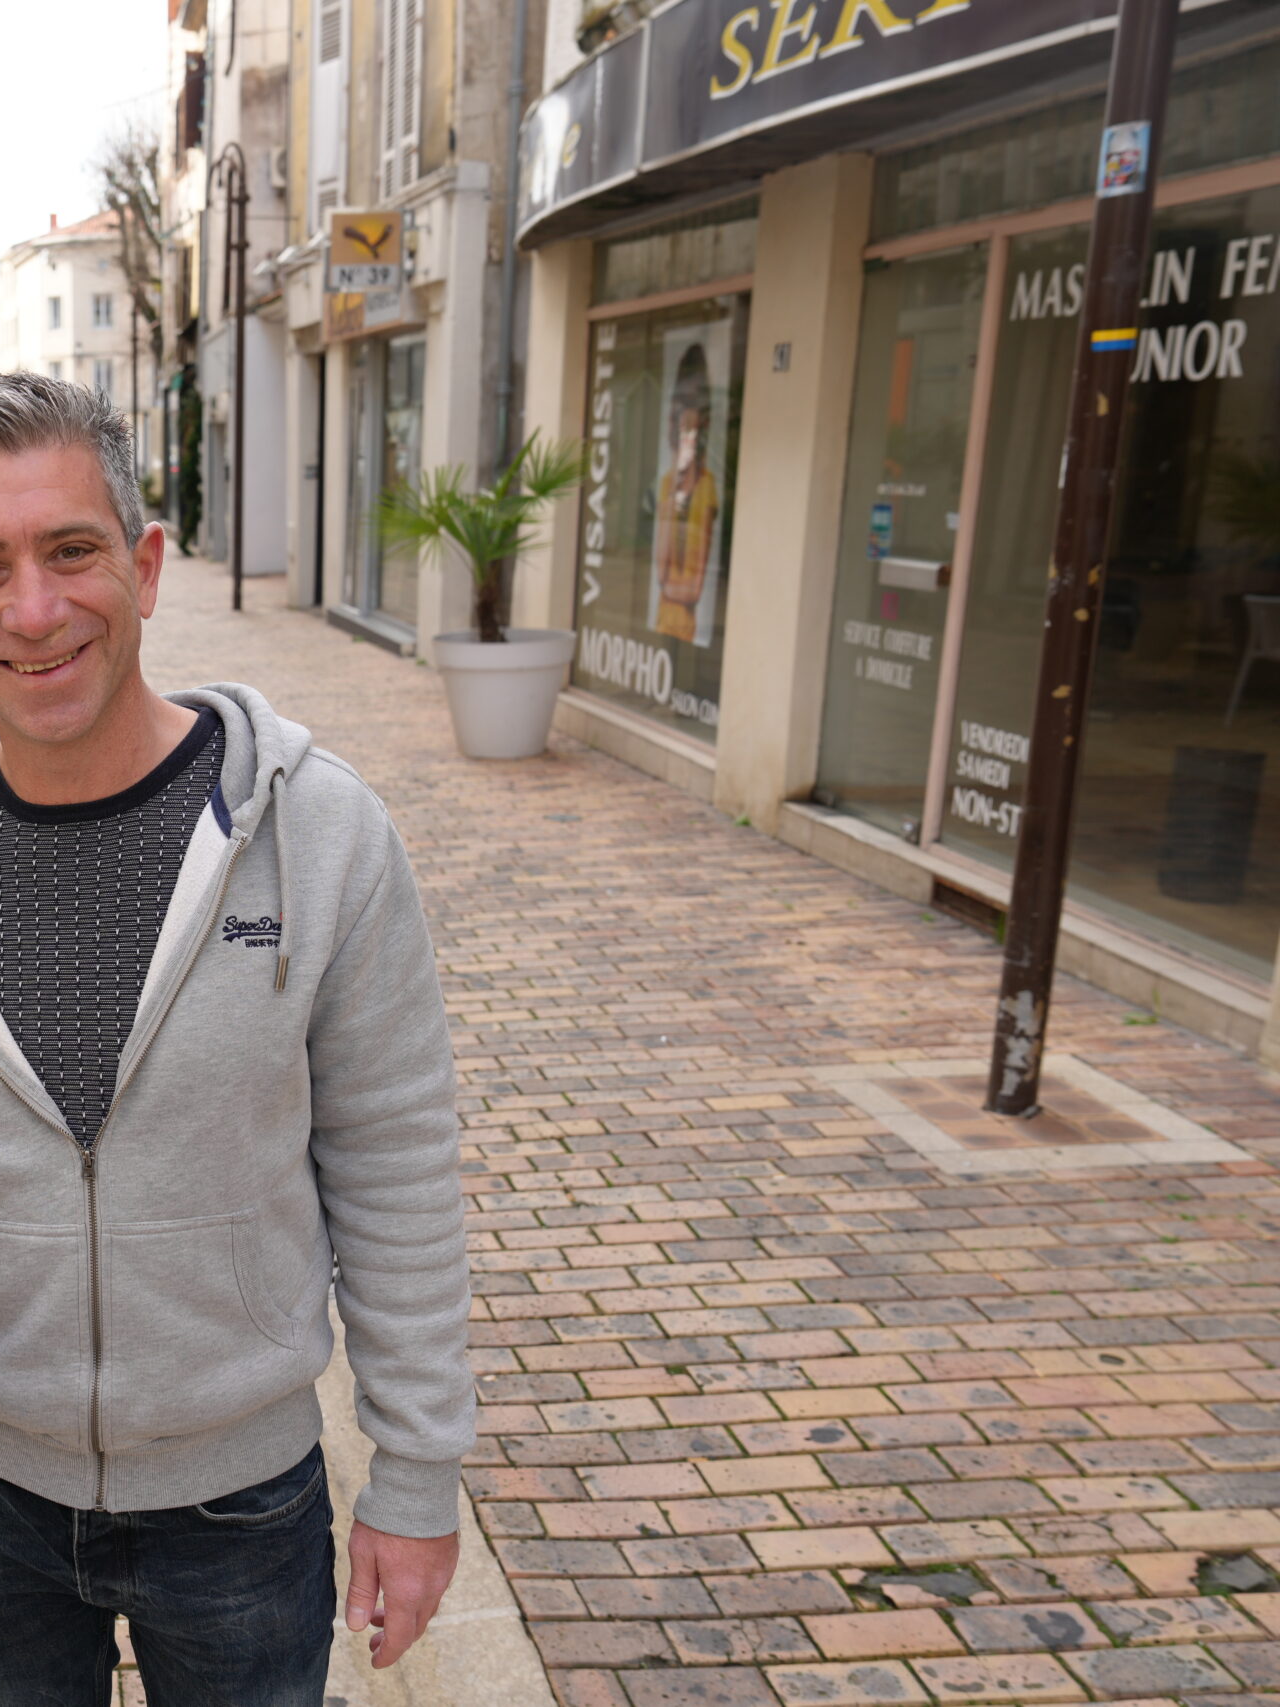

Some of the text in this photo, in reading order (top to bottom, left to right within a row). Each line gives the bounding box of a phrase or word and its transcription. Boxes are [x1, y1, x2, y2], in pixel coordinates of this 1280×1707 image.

[710, 0, 972, 99] SER
[368, 266, 392, 285] 39
[582, 322, 618, 606] VISAGISTE
[578, 625, 674, 705] MORPHO
[955, 750, 1012, 790] SAMEDI
[960, 719, 1031, 764] VENDREDI
